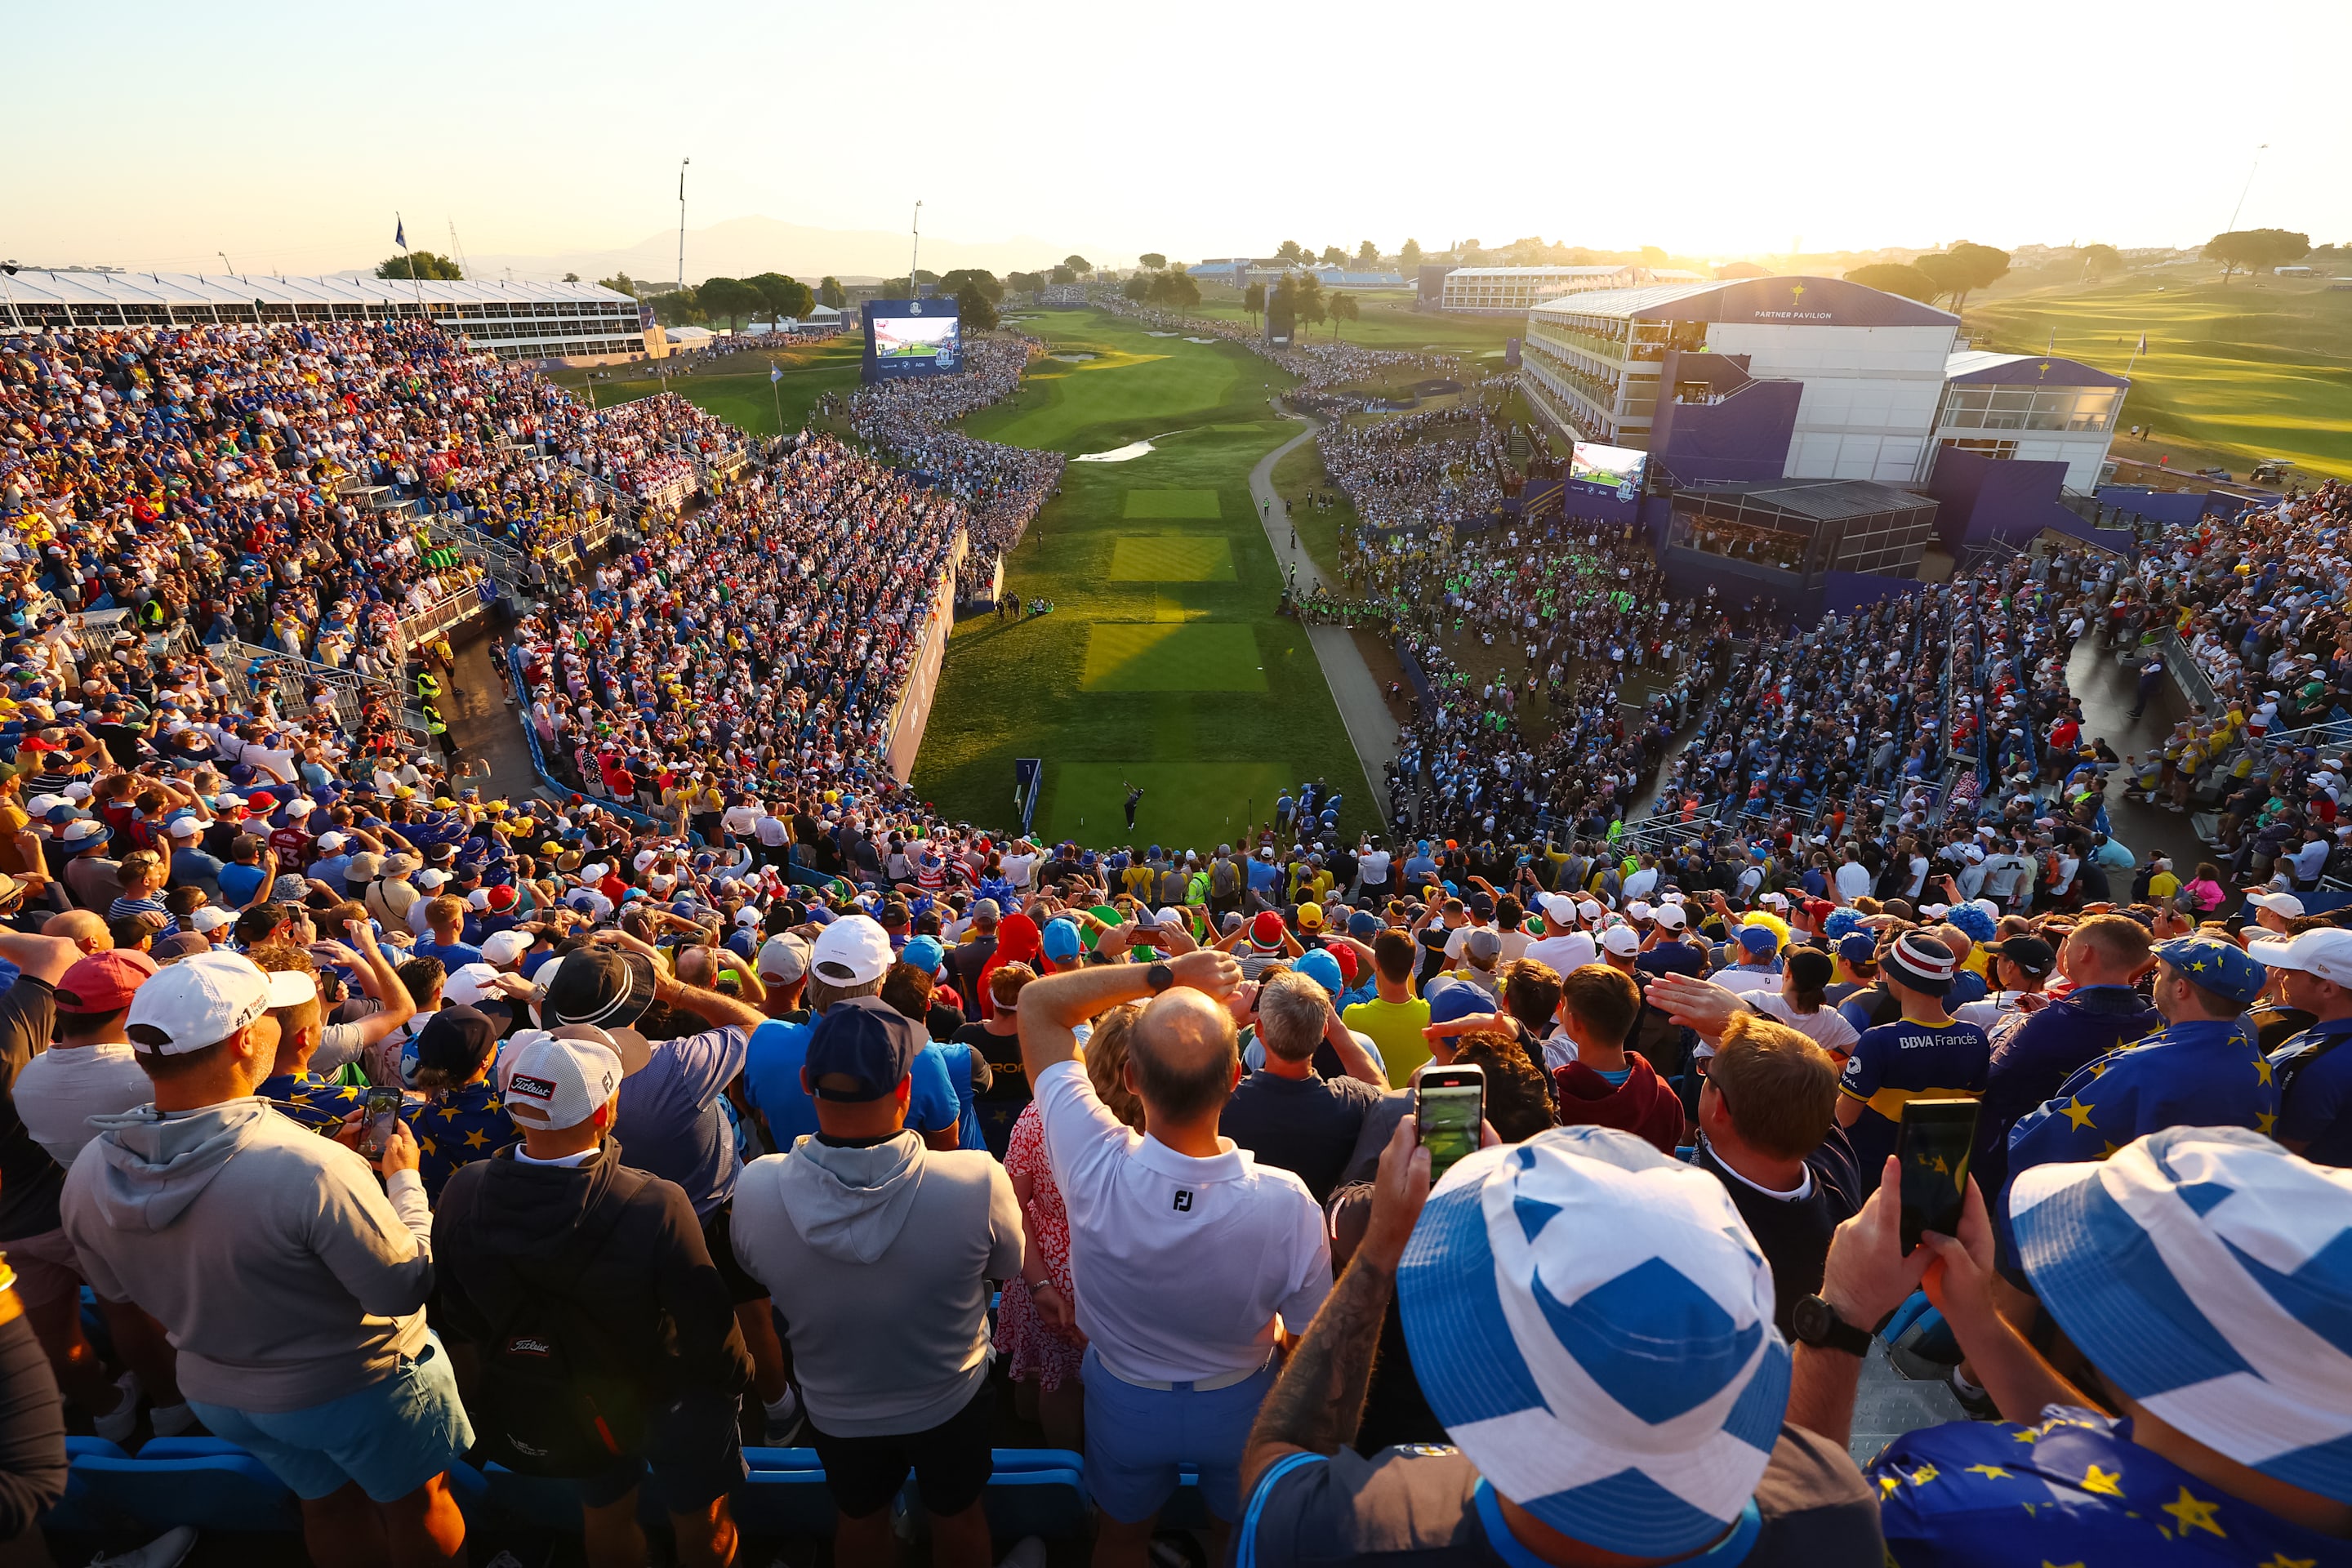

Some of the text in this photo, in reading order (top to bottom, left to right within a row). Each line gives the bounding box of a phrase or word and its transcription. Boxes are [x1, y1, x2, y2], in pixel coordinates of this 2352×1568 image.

[1026, 764, 1031, 775] 1
[274, 846, 300, 866] 13
[249, 994, 265, 1009] Team
[236, 1008, 252, 1027] #1
[1899, 1032, 1978, 1049] BBVA Francés
[511, 1077, 550, 1097] Titleist
[602, 1071, 614, 1094] FJ
[1173, 1190, 1193, 1213] FJ
[510, 1339, 550, 1352] Titleist
